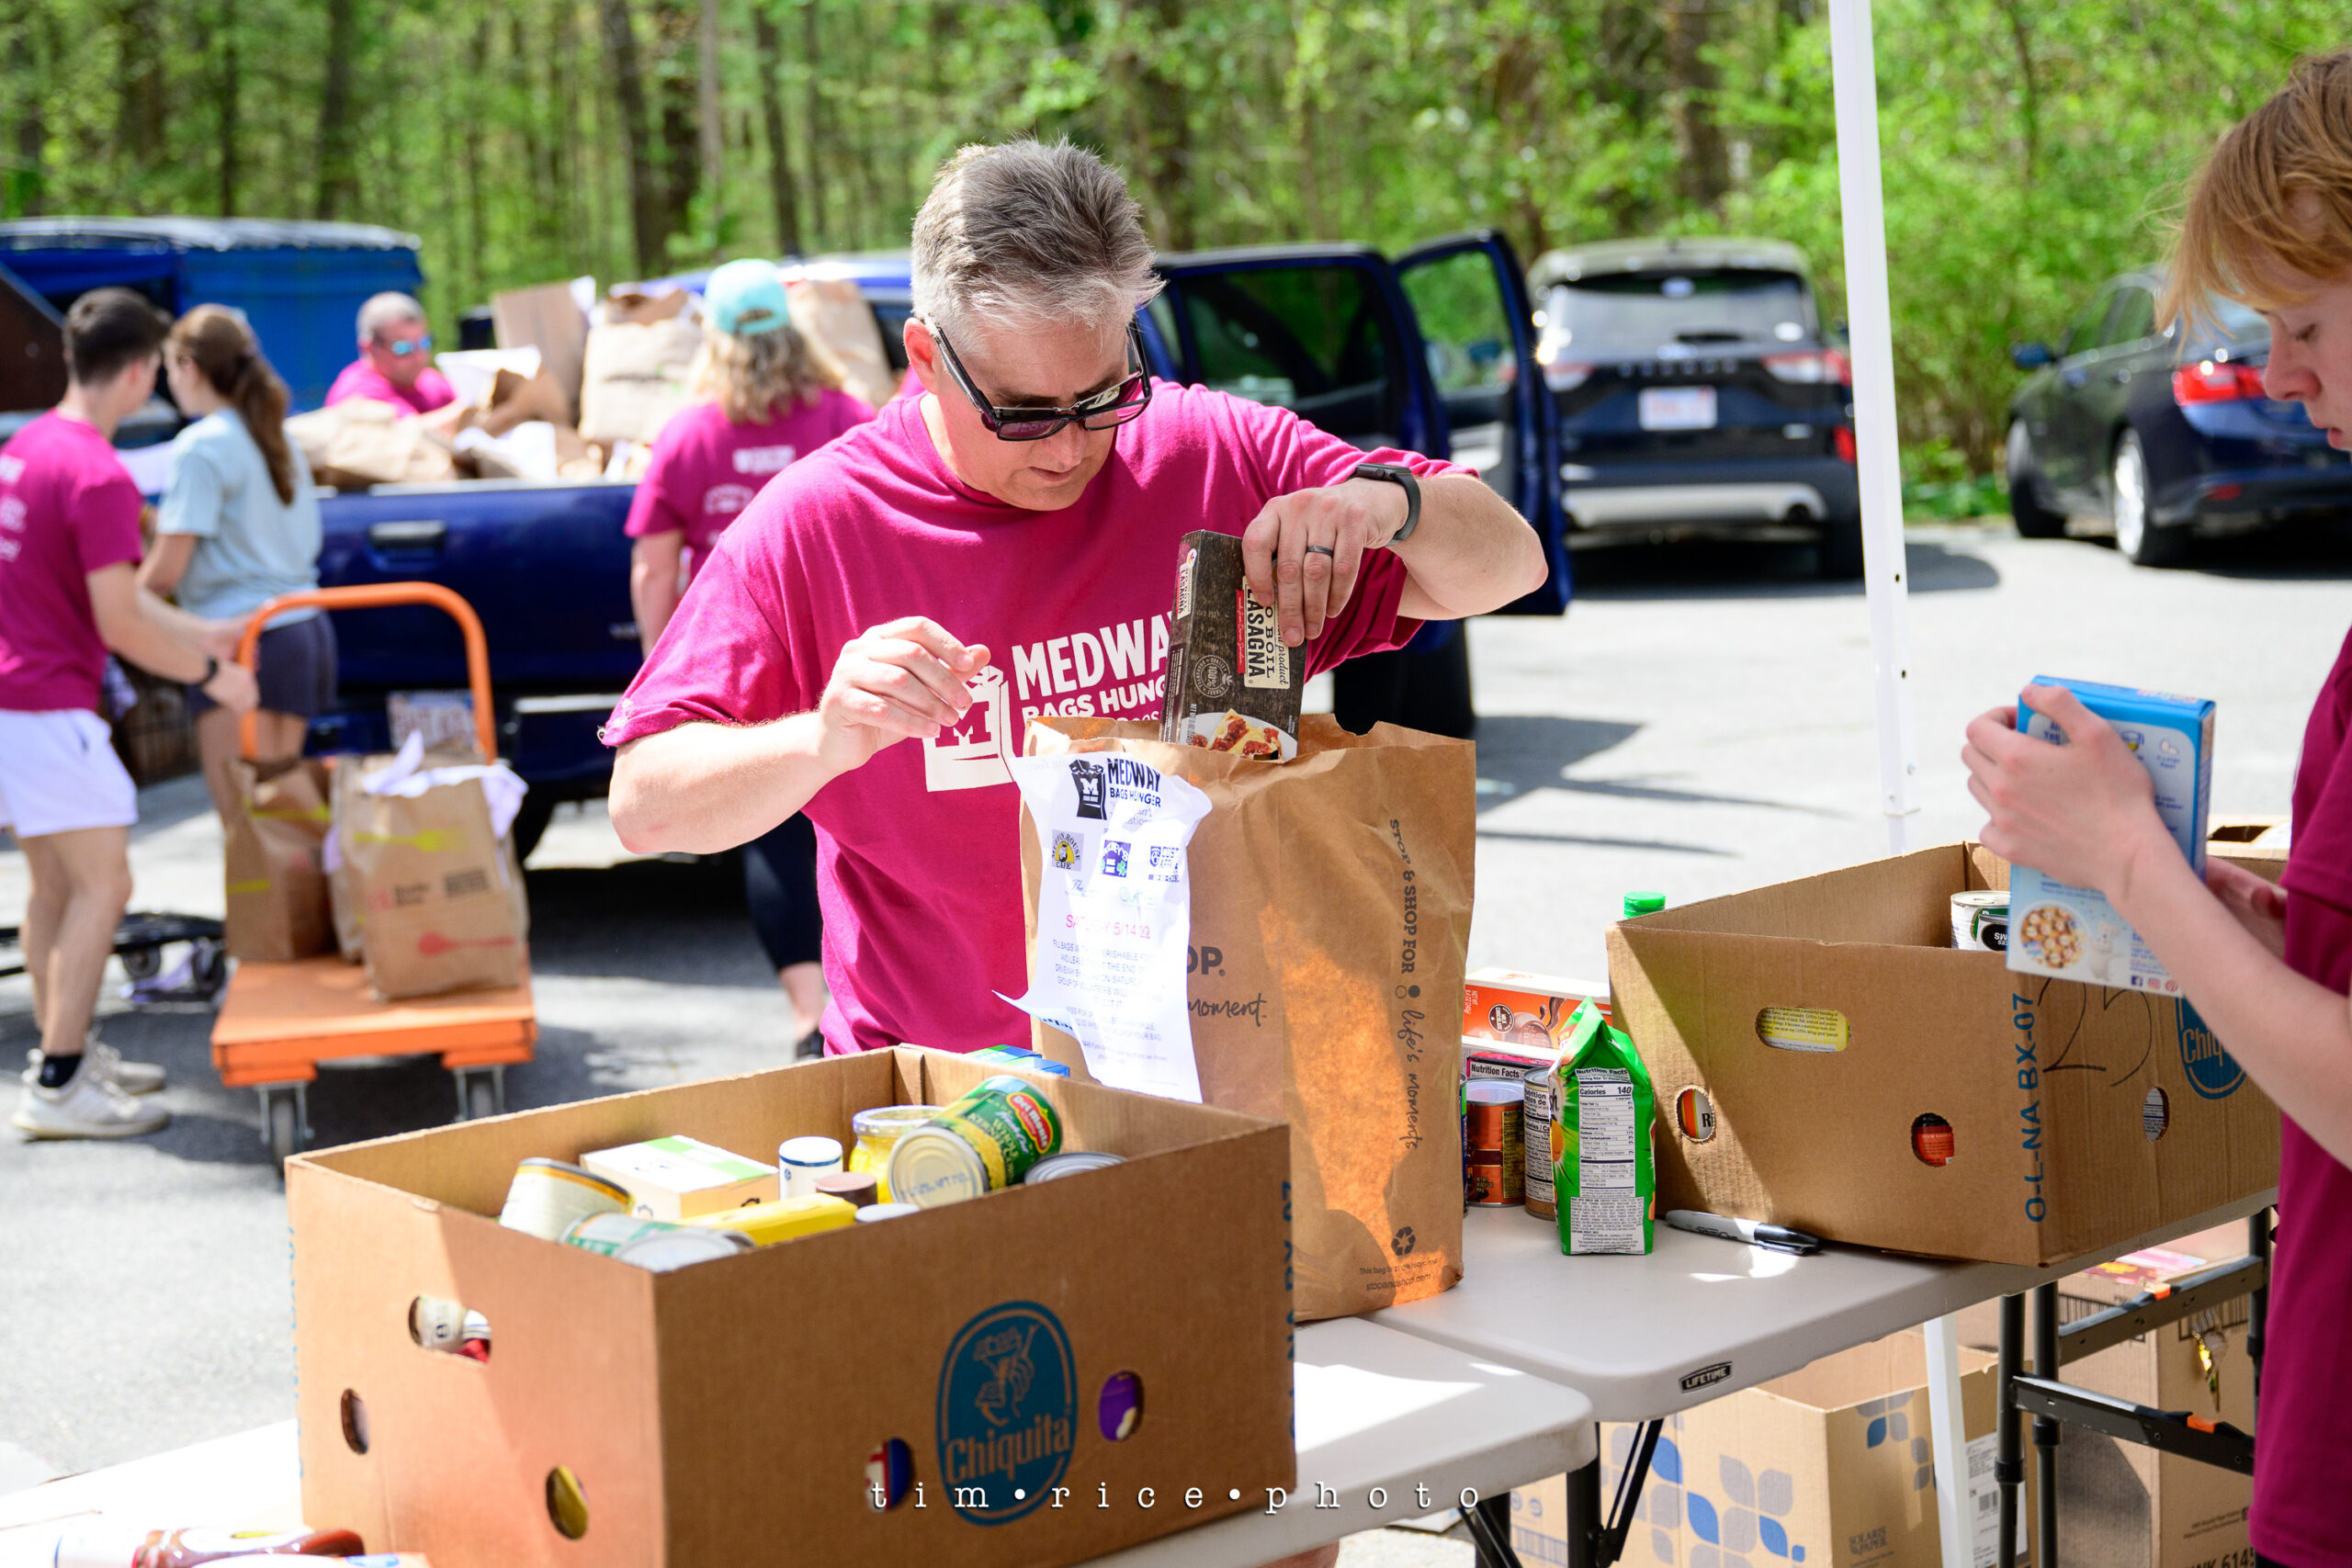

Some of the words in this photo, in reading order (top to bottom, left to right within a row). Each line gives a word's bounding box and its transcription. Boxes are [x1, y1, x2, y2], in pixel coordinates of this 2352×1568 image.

[1012, 611, 1174, 701] MEDWA
[1266, 625, 1275, 679] BOIL
[1275, 645, 1289, 685] product
[1099, 677, 1168, 715] HUNG
[1206, 666, 1218, 688] 100%
[1107, 758, 1161, 792] MEDWAY
[1110, 787, 1127, 800] BAGS
[1388, 818, 1411, 865] STOP
[1056, 862, 1072, 870] CAFE
[1402, 870, 1416, 883] &
[1404, 886, 1418, 936] SHOP
[1187, 944, 1224, 976] OP
[1401, 940, 1417, 975] FOR
[1396, 1010, 1426, 1063] life's
[2011, 992, 2040, 1090] BX-07
[2181, 1028, 2229, 1067] Chiq
[1471, 1064, 1500, 1076] Nutrition
[1501, 1067, 1520, 1078] Facts
[1617, 1086, 1632, 1095] 140
[1398, 1073, 1424, 1150] moments
[1685, 1367, 1728, 1389] LIFETIME
[944, 1413, 1071, 1485] Chiquita
